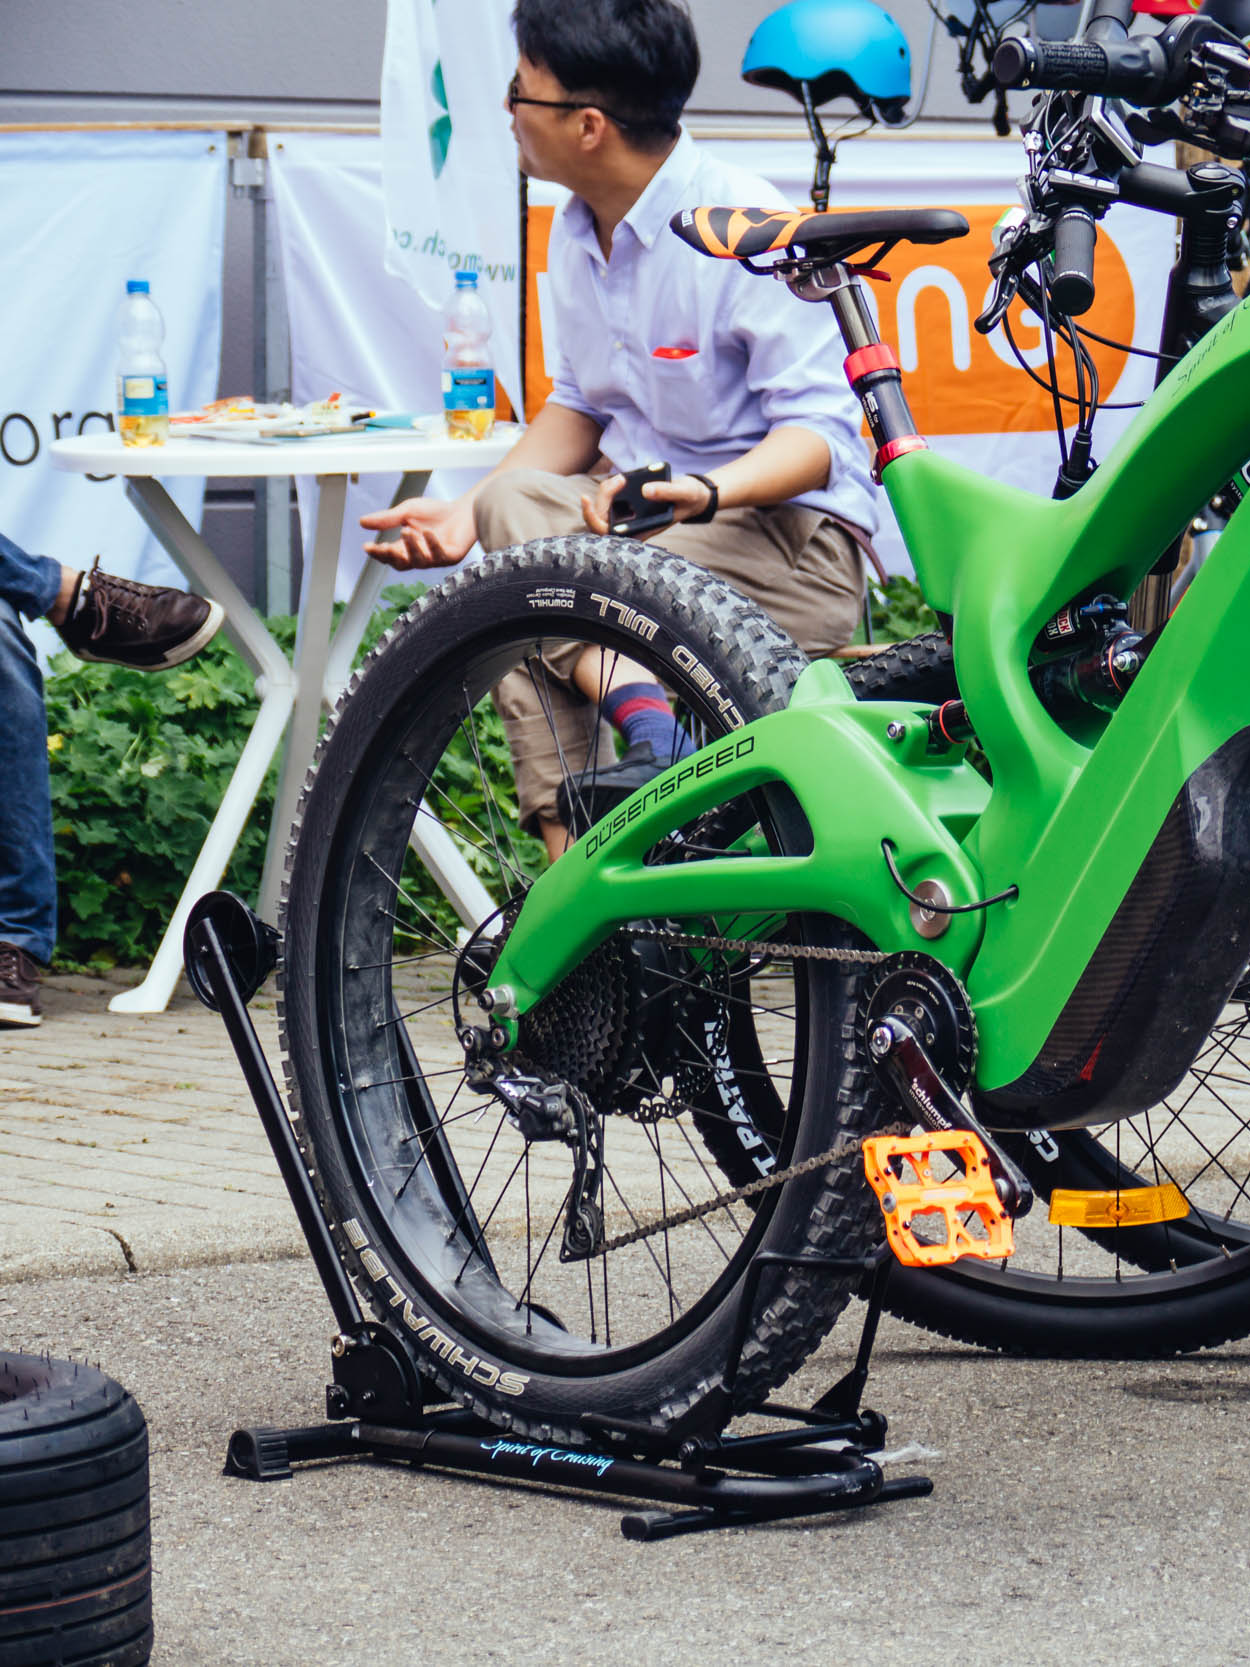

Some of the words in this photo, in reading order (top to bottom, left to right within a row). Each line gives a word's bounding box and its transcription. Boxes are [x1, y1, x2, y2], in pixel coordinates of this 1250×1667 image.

[528, 598, 574, 608] DOWNHILL
[590, 593, 660, 641] WILL
[672, 645, 745, 729] CKED
[586, 736, 755, 859] DÜSENSPEED
[912, 1077, 952, 1130] schlumpf
[342, 1218, 531, 1396] SCHWALBE
[480, 1440, 537, 1459] Spirit
[549, 1449, 615, 1477] Cruising
